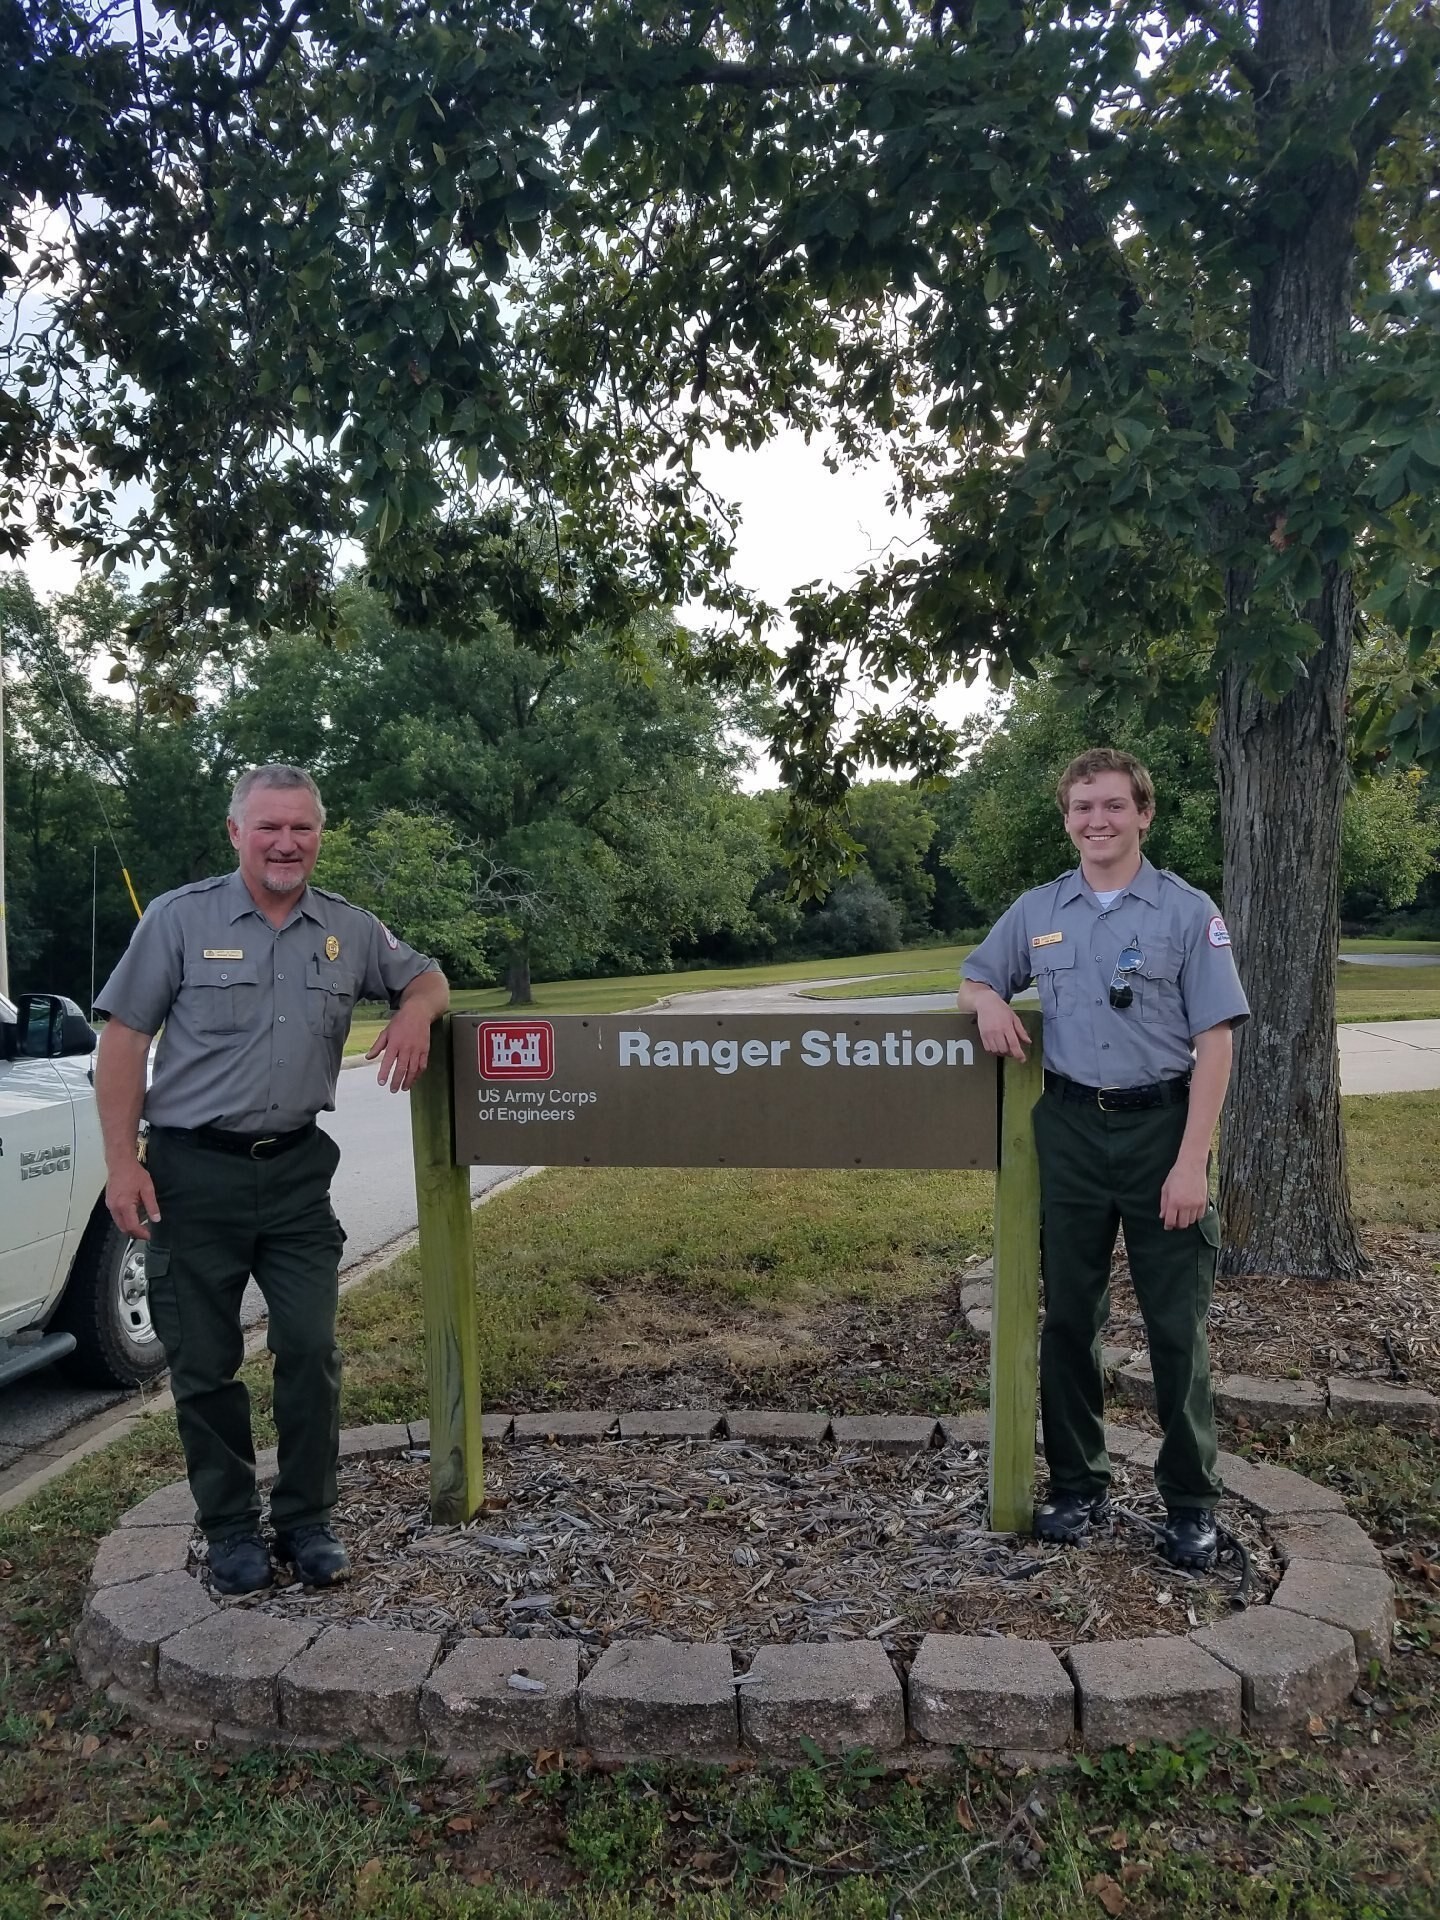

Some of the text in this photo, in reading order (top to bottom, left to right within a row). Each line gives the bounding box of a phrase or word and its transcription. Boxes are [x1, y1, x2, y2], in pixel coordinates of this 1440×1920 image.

[619, 1030, 974, 1075] Ranger Station
[478, 1089, 597, 1106] US Army Corps
[478, 1107, 576, 1123] of Engineers
[20, 1144, 71, 1166] RAM
[21, 1157, 71, 1181] 1500
